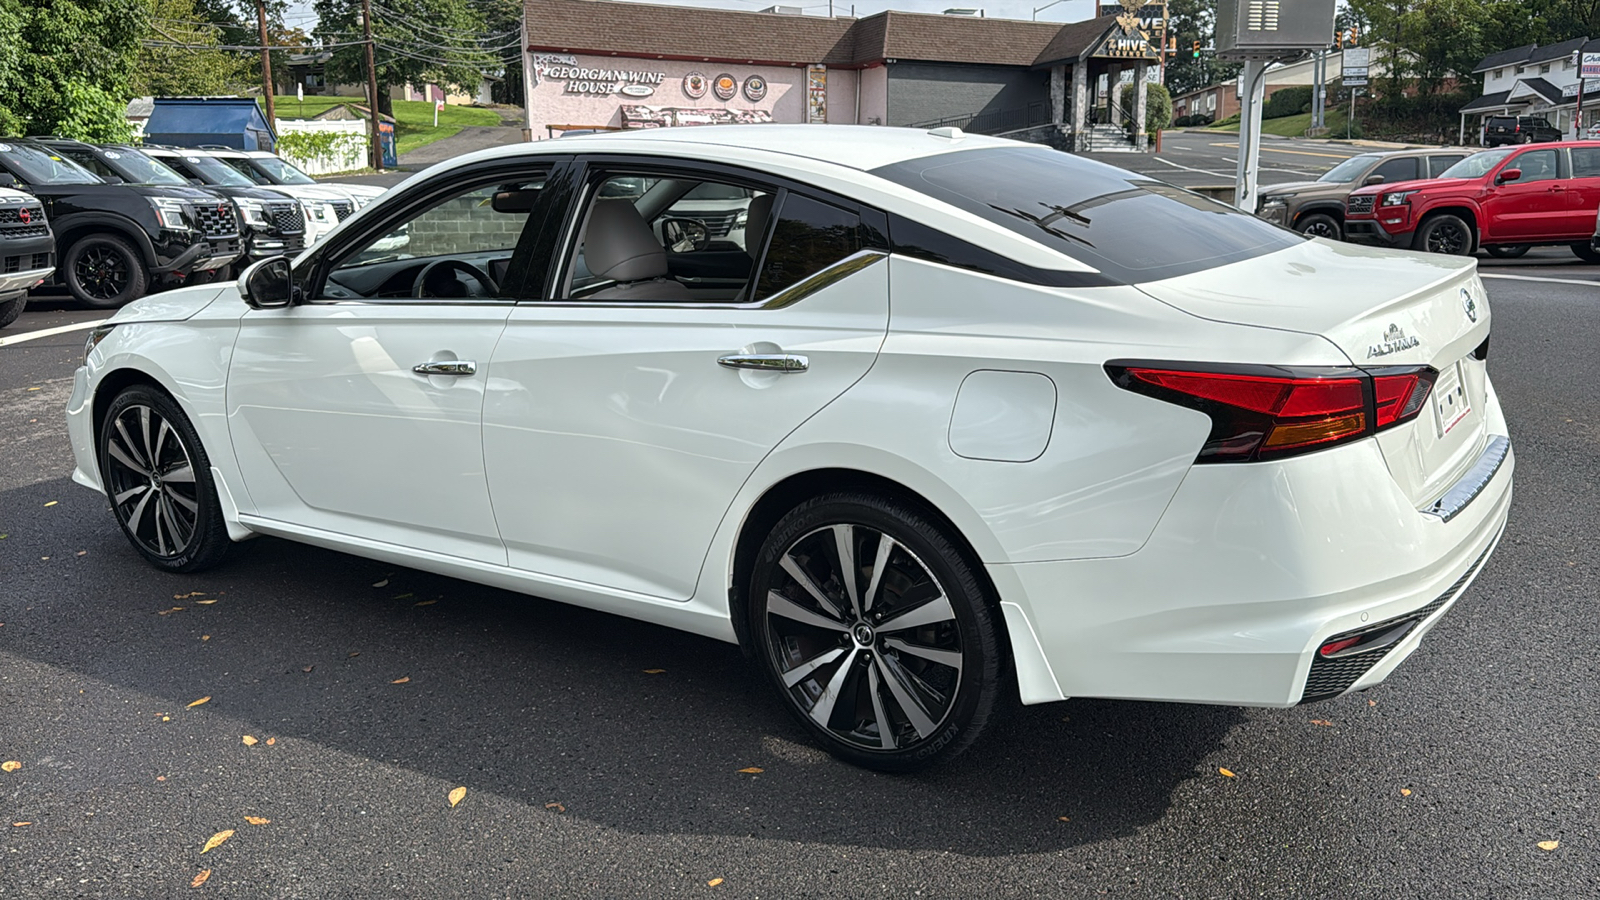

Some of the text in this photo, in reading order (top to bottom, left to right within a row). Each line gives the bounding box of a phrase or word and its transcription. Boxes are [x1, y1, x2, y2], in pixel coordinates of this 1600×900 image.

[1117, 39, 1147, 51] HIVE
[550, 66, 665, 85] GEORGIAN WINE
[568, 81, 615, 94] HOUSE
[1367, 335, 1421, 360] ALTIMA
